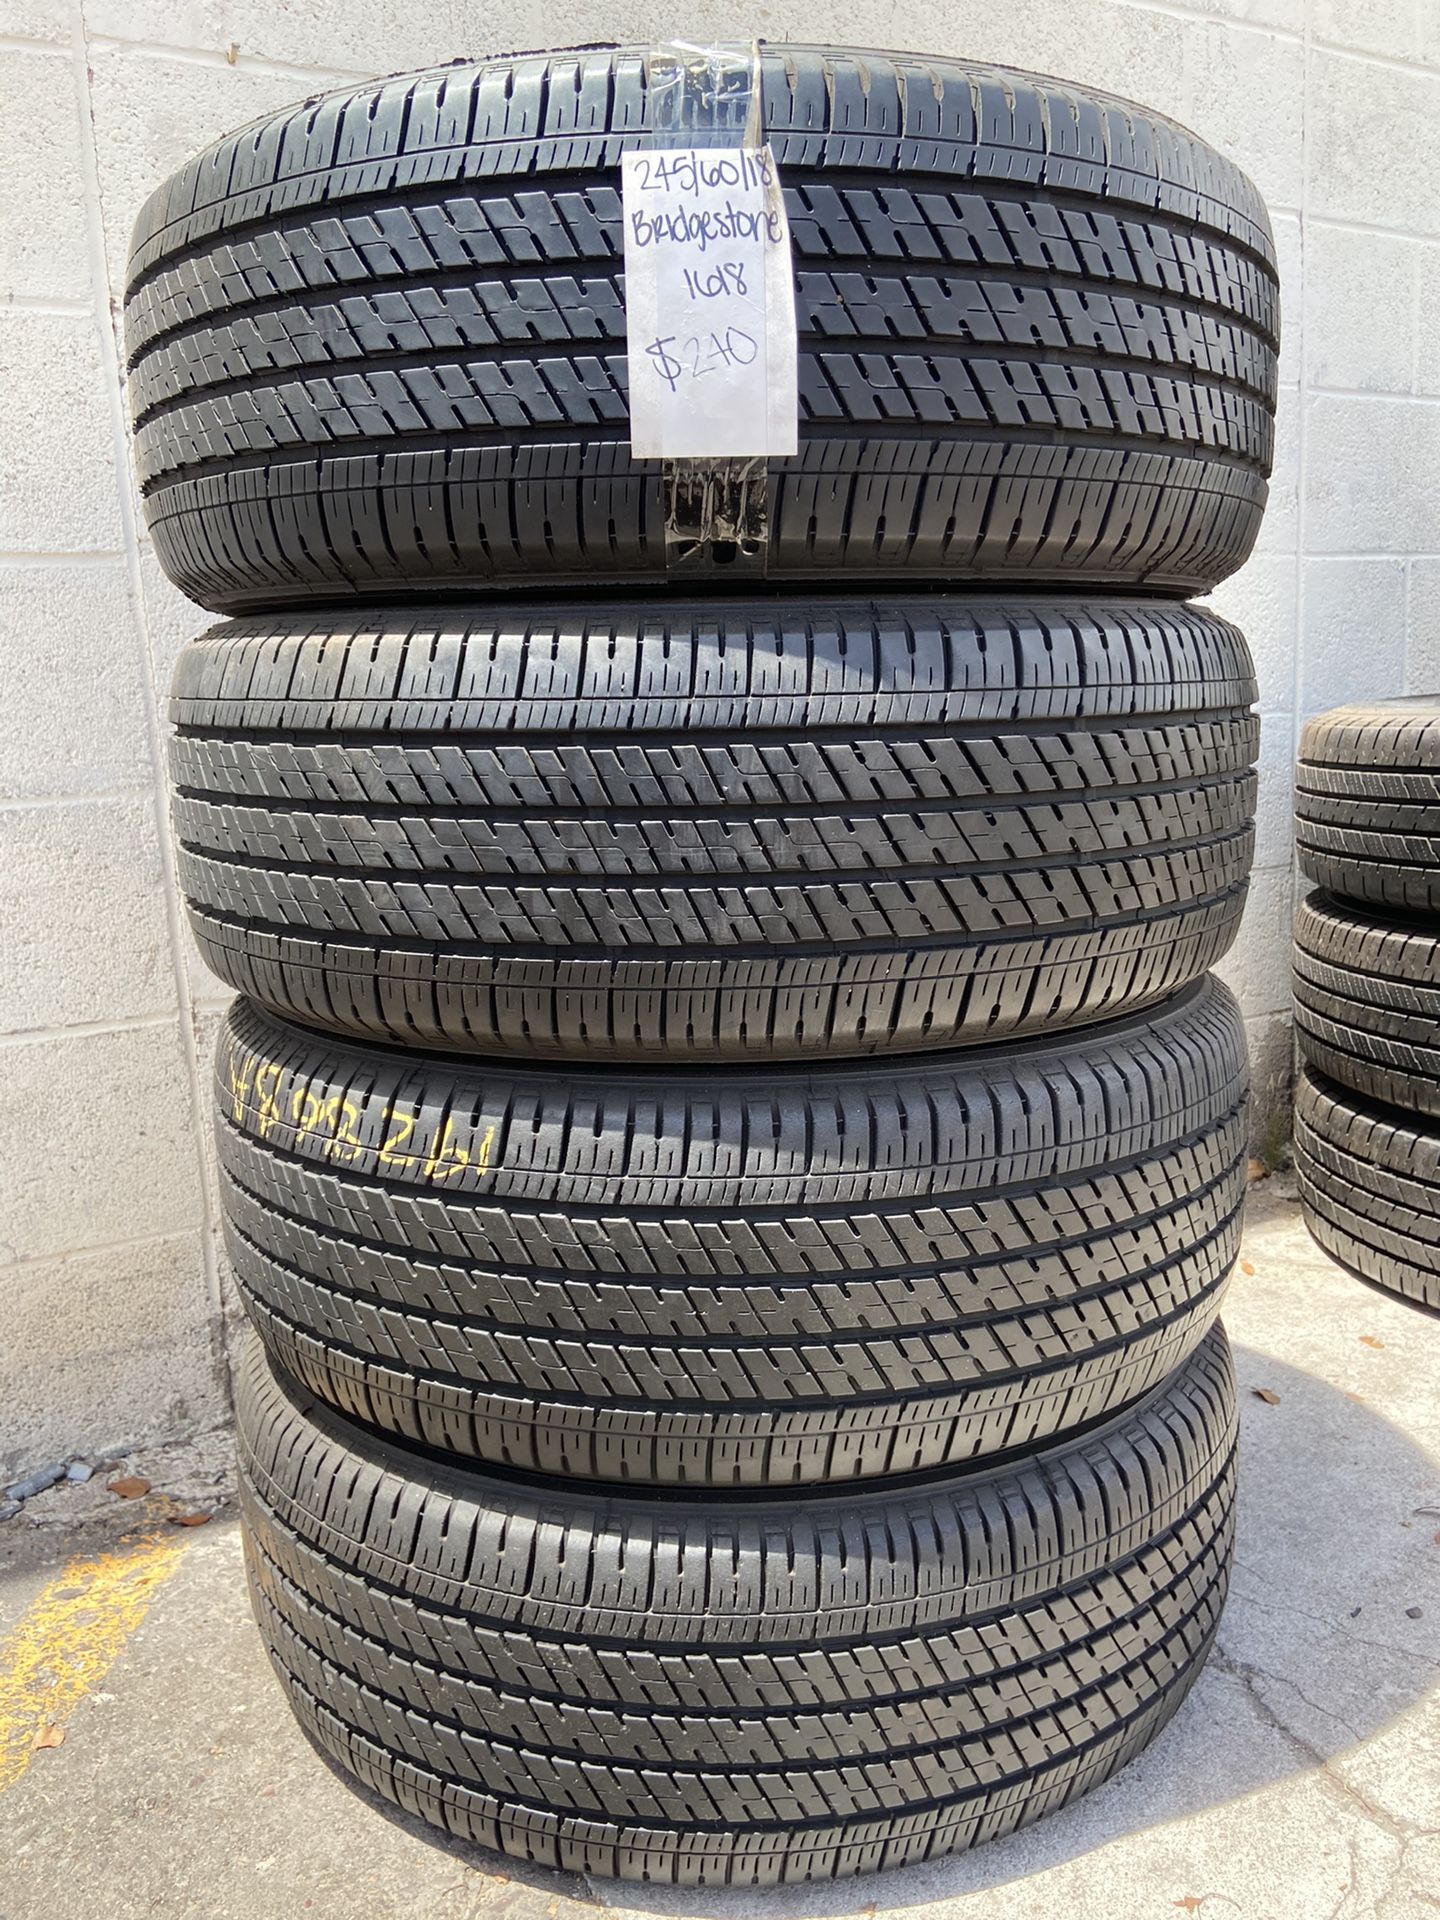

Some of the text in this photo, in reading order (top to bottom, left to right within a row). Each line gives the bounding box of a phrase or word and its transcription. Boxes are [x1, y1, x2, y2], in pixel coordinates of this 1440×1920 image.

[634, 150, 773, 197] 245/60/18
[683, 261, 748, 300] 1618
[645, 326, 758, 392] $240
